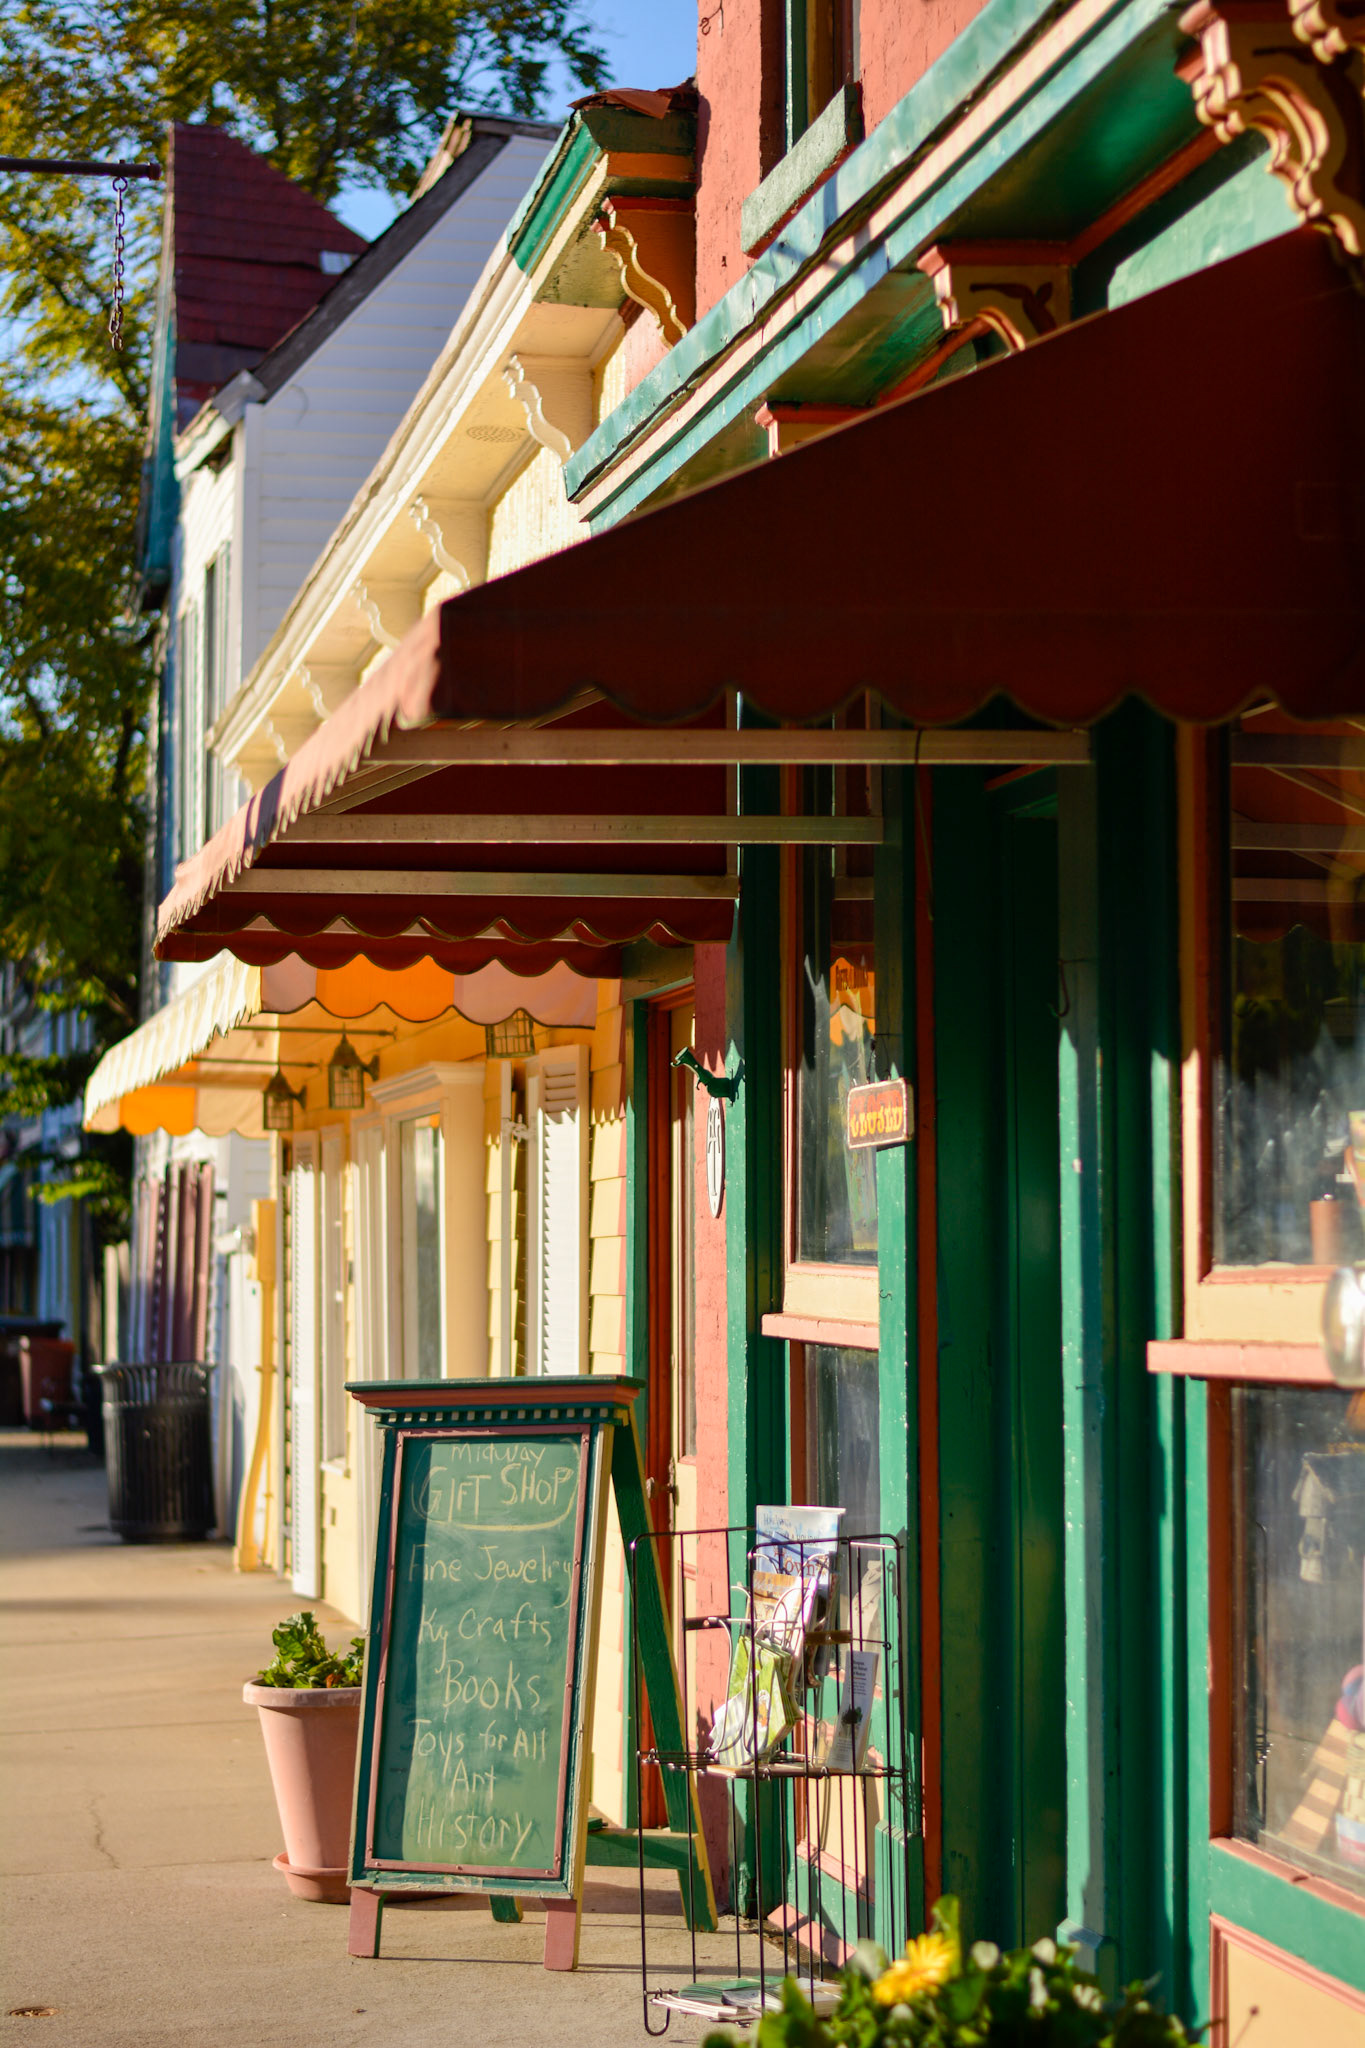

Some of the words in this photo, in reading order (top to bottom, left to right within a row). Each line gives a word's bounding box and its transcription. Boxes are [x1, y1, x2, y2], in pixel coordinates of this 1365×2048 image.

[419, 1465, 492, 1522] GIFT
[501, 1462, 574, 1505] SHOP
[409, 1543, 462, 1582] Fine
[474, 1544, 573, 1608] Jewelry
[418, 1604, 449, 1674] Ky
[458, 1602, 551, 1647] Crafts
[408, 1718, 465, 1781] Toys
[479, 1719, 508, 1753] for
[514, 1727, 546, 1761] All
[450, 1758, 497, 1801] Art
[416, 1797, 533, 1863] History
